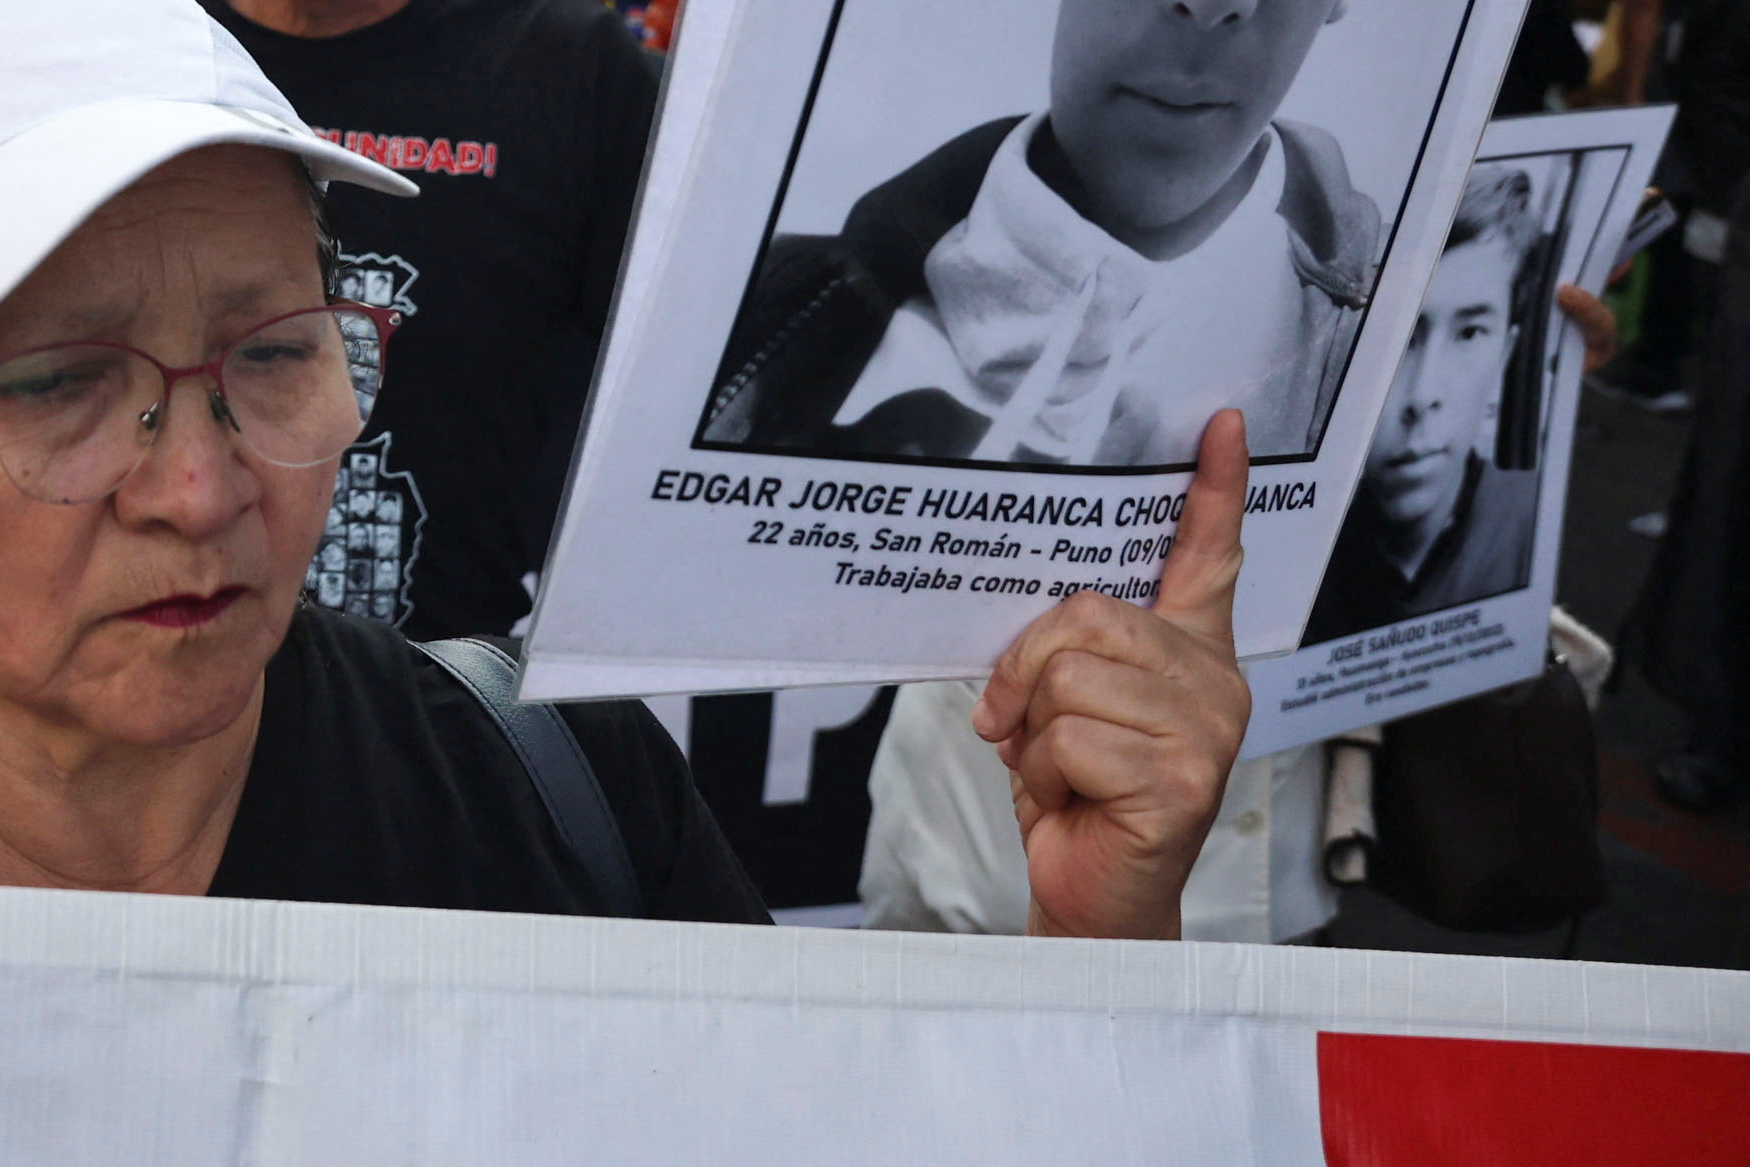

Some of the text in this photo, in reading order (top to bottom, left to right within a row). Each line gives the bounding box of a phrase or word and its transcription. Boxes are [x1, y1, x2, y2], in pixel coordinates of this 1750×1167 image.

[650, 470, 783, 508] EDGAR
[789, 479, 912, 516] JORGE
[917, 486, 1103, 528] HUARANCA
[748, 521, 782, 545] 22
[788, 523, 862, 554] años,
[870, 528, 921, 553] San
[926, 533, 1021, 560] Román
[1050, 539, 1110, 564] Puno
[1119, 534, 1174, 567] (09/0
[833, 561, 961, 595] Trabajaba
[968, 573, 1041, 597] como
